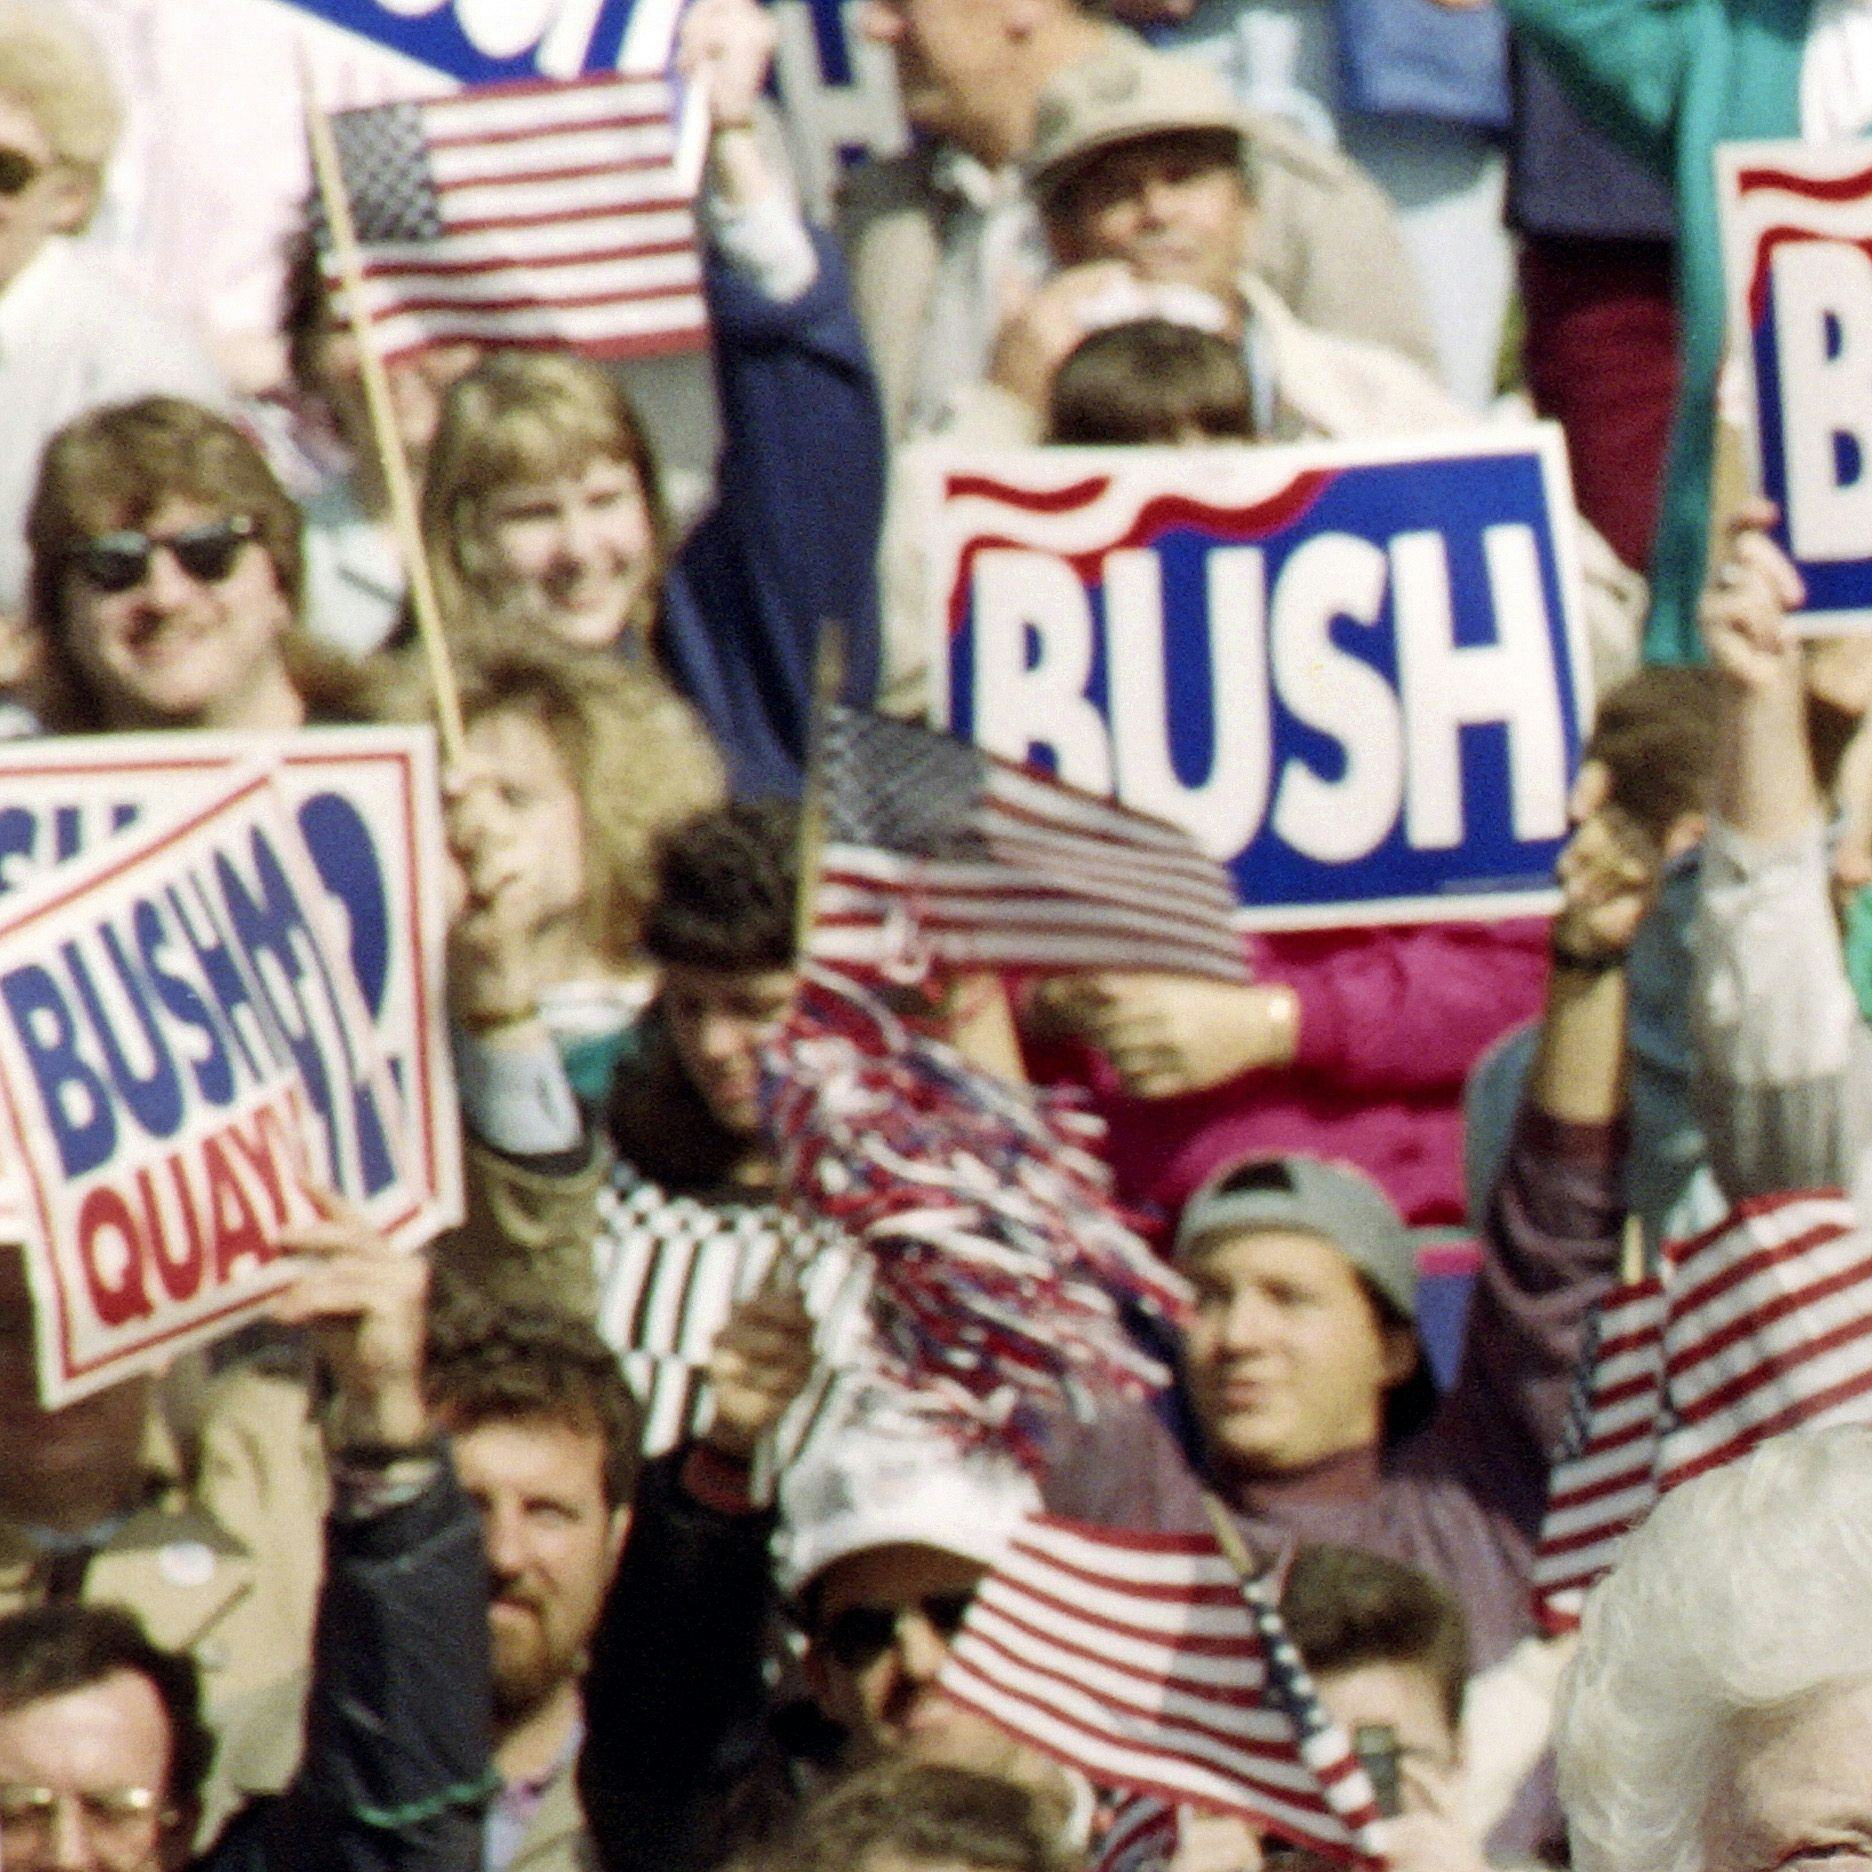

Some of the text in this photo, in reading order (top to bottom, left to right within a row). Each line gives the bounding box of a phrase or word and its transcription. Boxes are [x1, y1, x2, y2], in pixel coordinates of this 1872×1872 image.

[970, 523, 1568, 864] BUSH
[2, 868, 292, 1180] BUSH
[76, 1085, 335, 1327] QUAY
